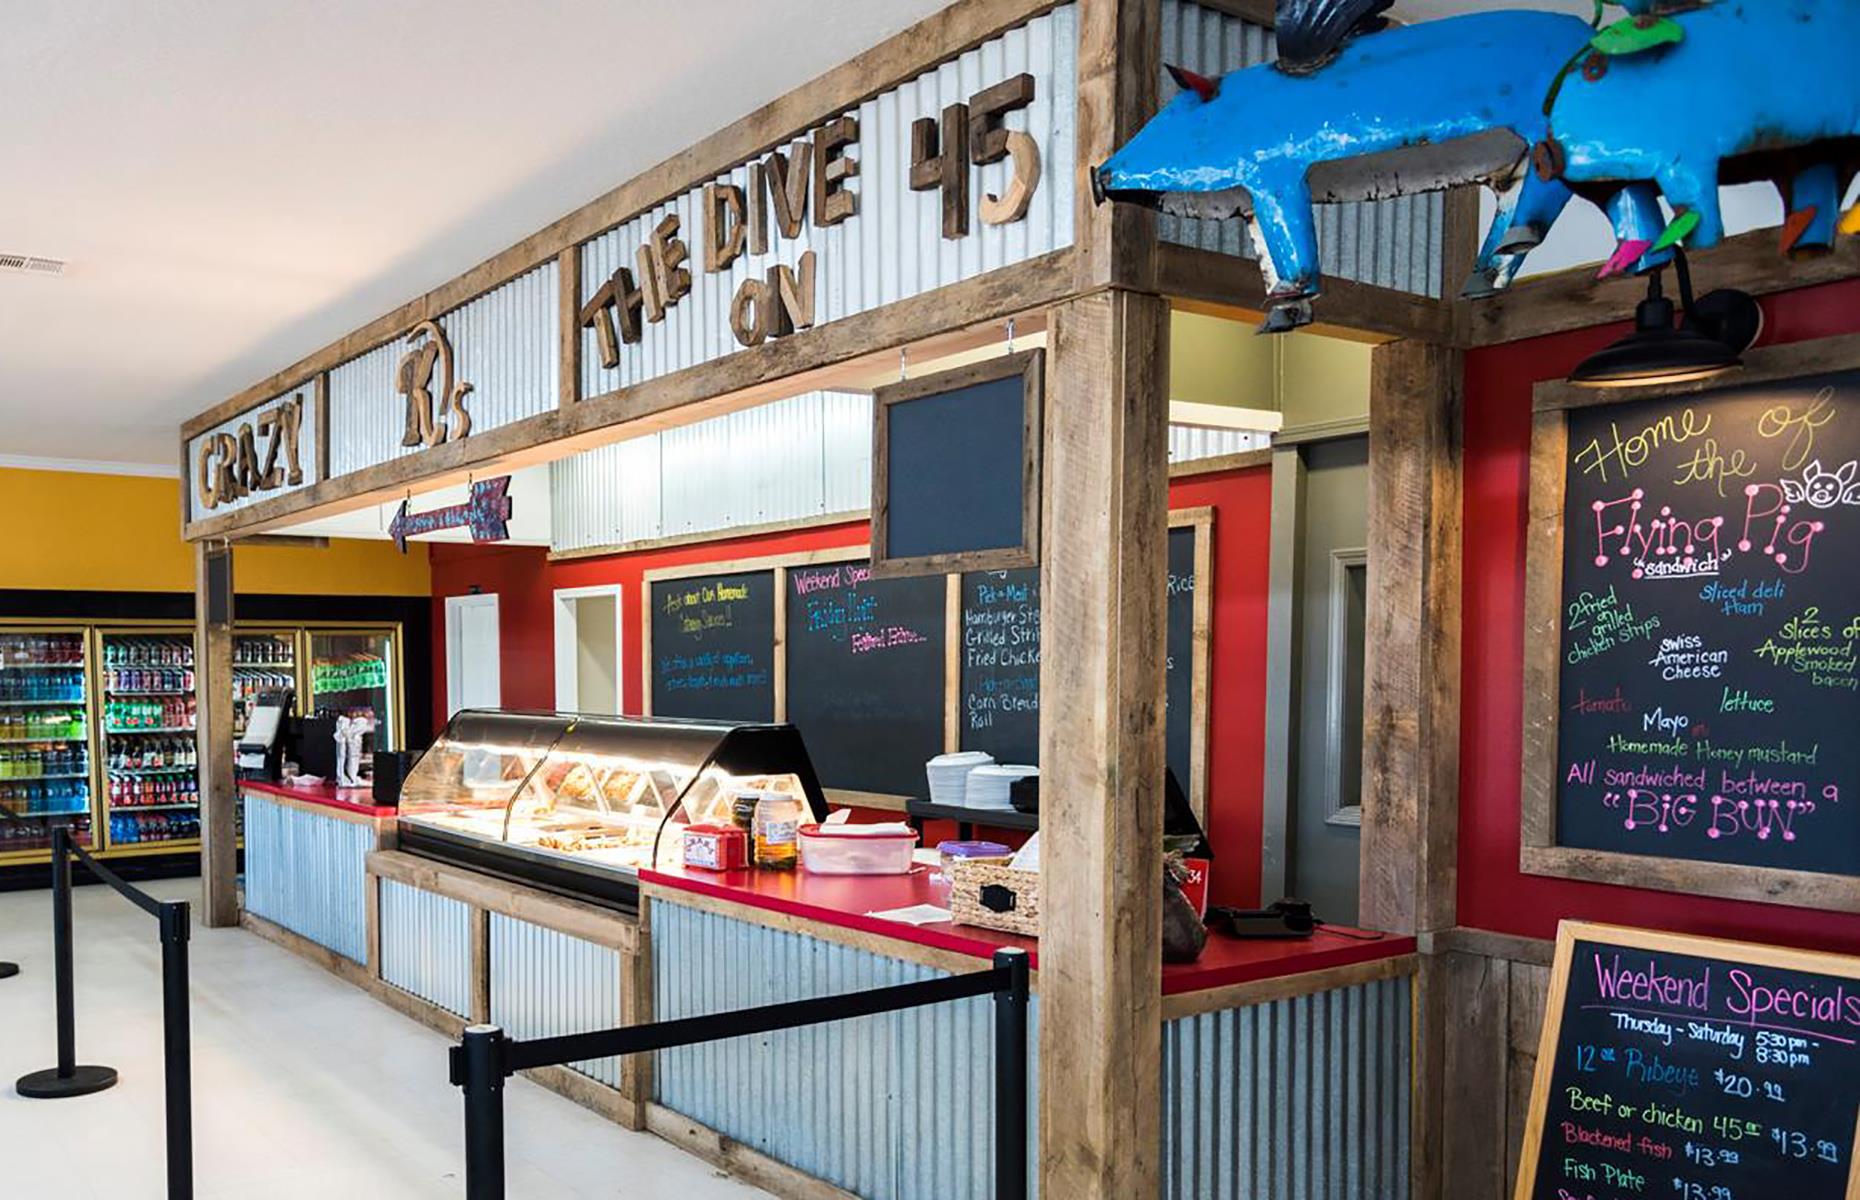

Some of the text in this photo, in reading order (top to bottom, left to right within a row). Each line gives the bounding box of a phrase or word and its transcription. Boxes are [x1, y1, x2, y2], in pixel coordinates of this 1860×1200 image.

[910, 71, 1041, 240] 45
[580, 115, 861, 369] THE DIVE
[730, 250, 817, 347] ON
[1574, 386, 1835, 482] Home of
[199, 393, 303, 510] CRAZY
[1673, 439, 1757, 497] the
[1592, 484, 1825, 579] Flying Pig
[794, 567, 841, 595] Weekend
[1752, 581, 1786, 598] deli
[1018, 603, 1040, 625] Ste
[1568, 584, 1618, 631] 2 fried
[1592, 603, 1633, 640] grilled
[1721, 600, 1763, 616] Ham
[1801, 606, 1819, 625] 2
[965, 627, 1006, 647] Grilled
[1568, 635, 1615, 664] chicken
[1752, 638, 1852, 666] Applewood
[968, 648, 997, 668] Fried
[1649, 649, 1728, 668] American
[1662, 664, 1721, 681] Cheese
[968, 692, 997, 711] Corn
[1720, 686, 1775, 714] lettuce
[1643, 706, 1689, 738] Mayo
[1606, 733, 1818, 769] Homemade Honey mustard
[1567, 760, 1839, 803] All sandwiched between a
[1594, 953, 1860, 1028] Weekend Specials
[1610, 1012, 1673, 1046] Thursday
[1688, 1021, 1745, 1060] Saturday
[1576, 1045, 1597, 1073] 12
[1565, 1086, 1613, 1116] Beef
[1617, 1104, 1638, 1119] or
[1642, 1102, 1704, 1135] chicken
[1770, 1127, 1839, 1164] $13.99
[1684, 1141, 1740, 1167] $13.99
[1564, 1157, 1646, 1193] Fish Plate
